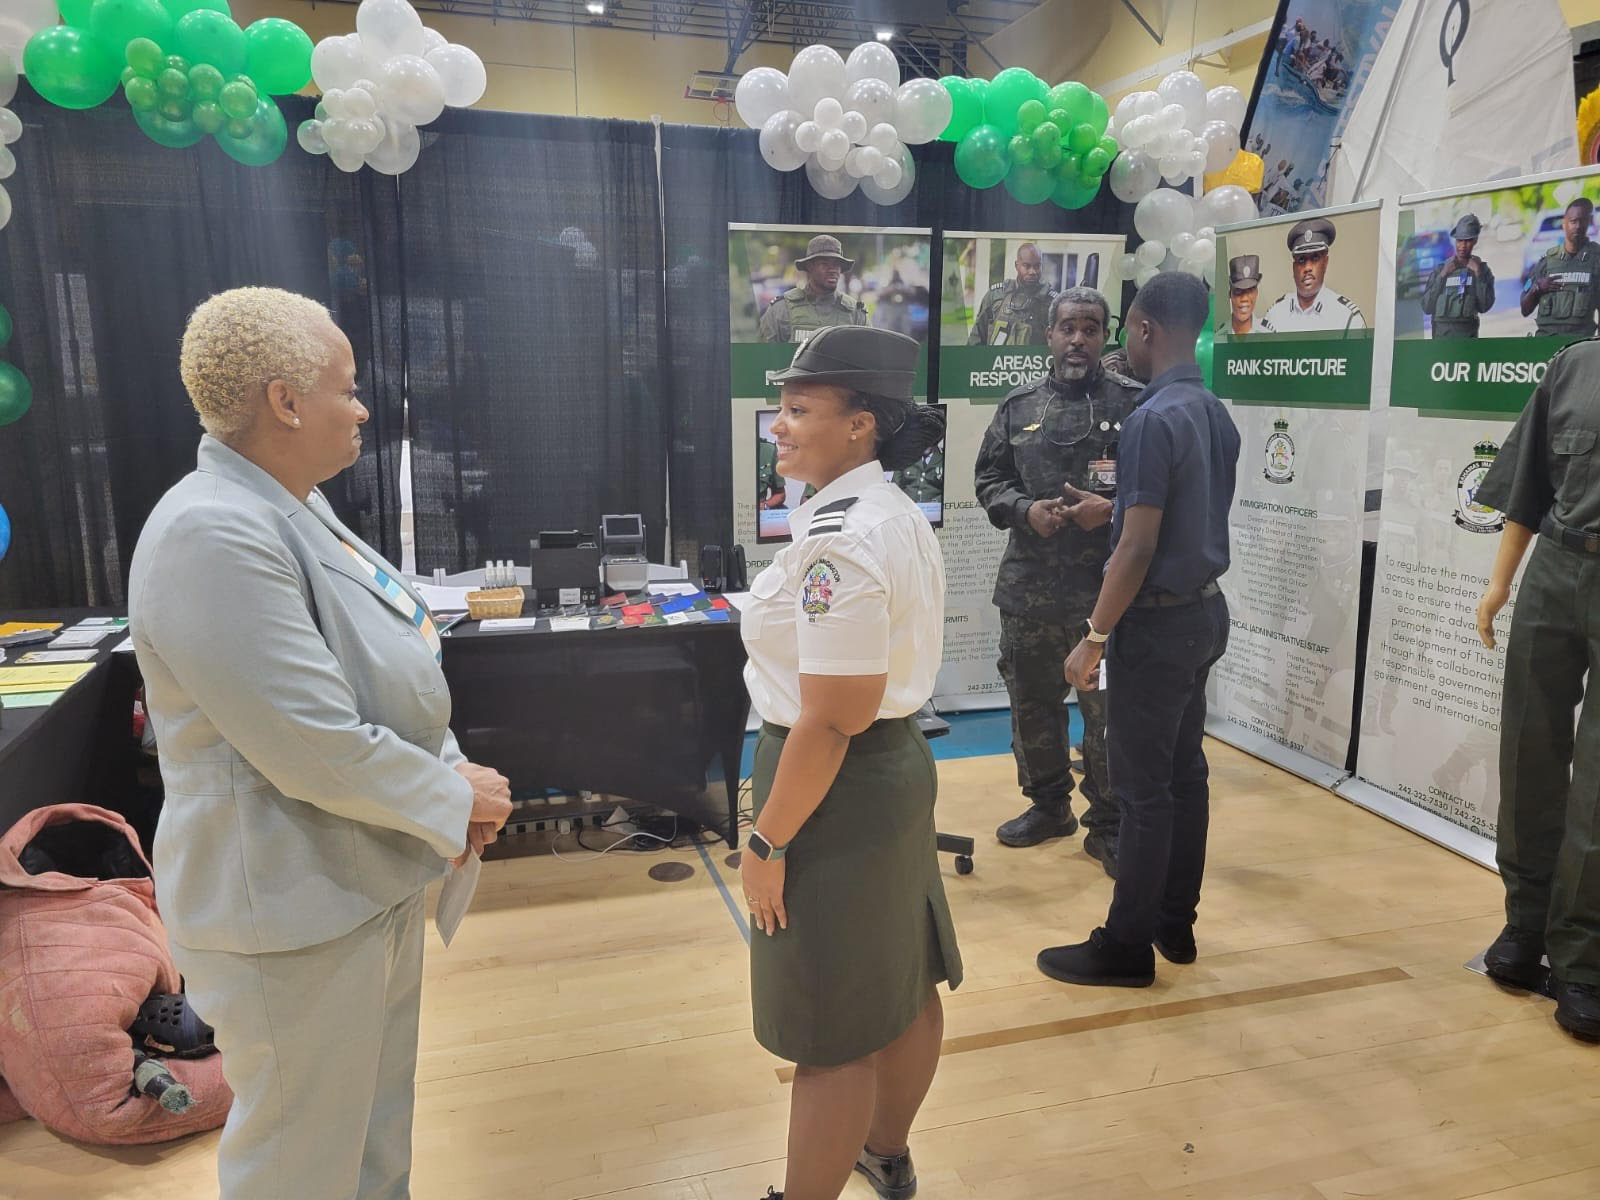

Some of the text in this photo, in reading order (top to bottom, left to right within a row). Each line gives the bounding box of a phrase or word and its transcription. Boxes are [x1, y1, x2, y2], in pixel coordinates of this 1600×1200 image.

[992, 355, 1043, 371] AREAS
[1227, 358, 1347, 376] RANK STRUCTURE
[1431, 362, 1548, 384] OUR MISSIO
[969, 371, 1050, 387] RESPONS
[945, 501, 974, 510] EFUGEE
[1240, 499, 1318, 519] IMMIGRATION OFFICERS
[745, 561, 773, 569] ORDER
[1386, 555, 1394, 567] To
[1397, 560, 1437, 575] regulate
[1440, 566, 1457, 579] the
[1386, 573, 1415, 586] across
[1418, 577, 1434, 590] the
[1437, 580, 1478, 600] borders
[1392, 589, 1403, 598] as
[1405, 590, 1415, 601] to
[1418, 595, 1451, 609] ensure
[1454, 601, 1471, 614] the
[944, 615, 968, 624] ERMITS
[1397, 605, 1445, 622] economic
[1229, 619, 1248, 631] ERICAL
[1307, 641, 1330, 655] STAFF
[1391, 618, 1431, 635] promote
[1434, 627, 1451, 640] the
[1392, 630, 1456, 656] development
[1460, 649, 1472, 660] of
[1475, 651, 1494, 667] The
[1381, 640, 1414, 661] through
[1417, 652, 1434, 665] the
[1436, 659, 1505, 686] collaborative
[1382, 658, 1502, 701] responsible government
[1374, 670, 1501, 716] government agencies bot
[1412, 697, 1431, 709] and
[1398, 783, 1448, 810] 242-322-7530
[1428, 786, 1463, 804] CONTACT
